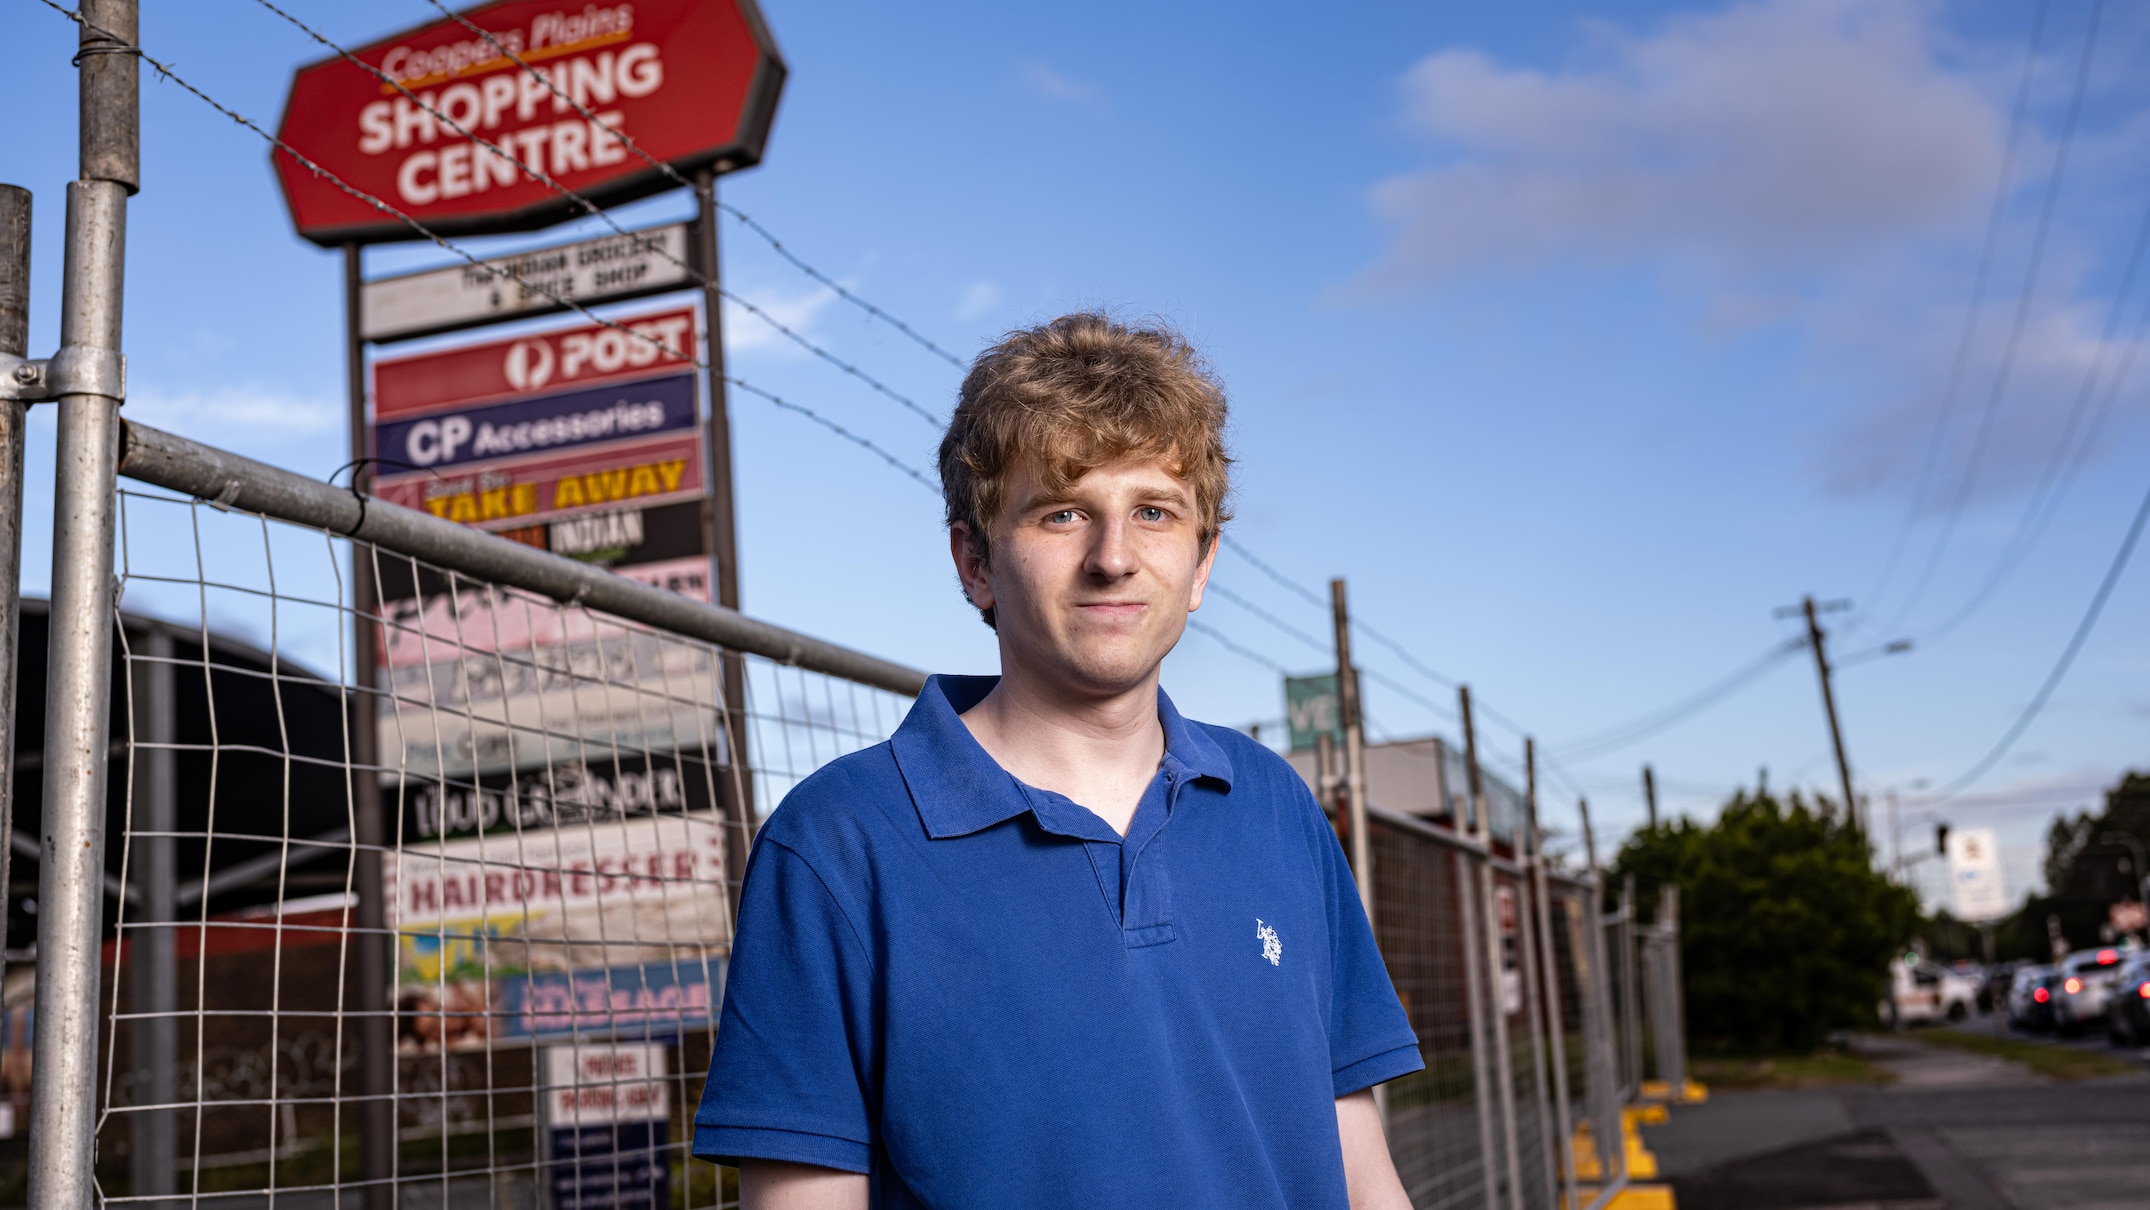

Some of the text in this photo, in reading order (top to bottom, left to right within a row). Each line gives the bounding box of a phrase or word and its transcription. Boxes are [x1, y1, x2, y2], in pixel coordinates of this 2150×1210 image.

[380, 4, 635, 83] Coopers Plains
[358, 43, 664, 155] SHOPPING
[397, 111, 627, 204] CENTRE
[561, 318, 689, 377] POST
[406, 399, 666, 465] CP Accessories
[424, 458, 687, 524] TAKE AWAY
[410, 852, 699, 914] HAIRDRESSER
